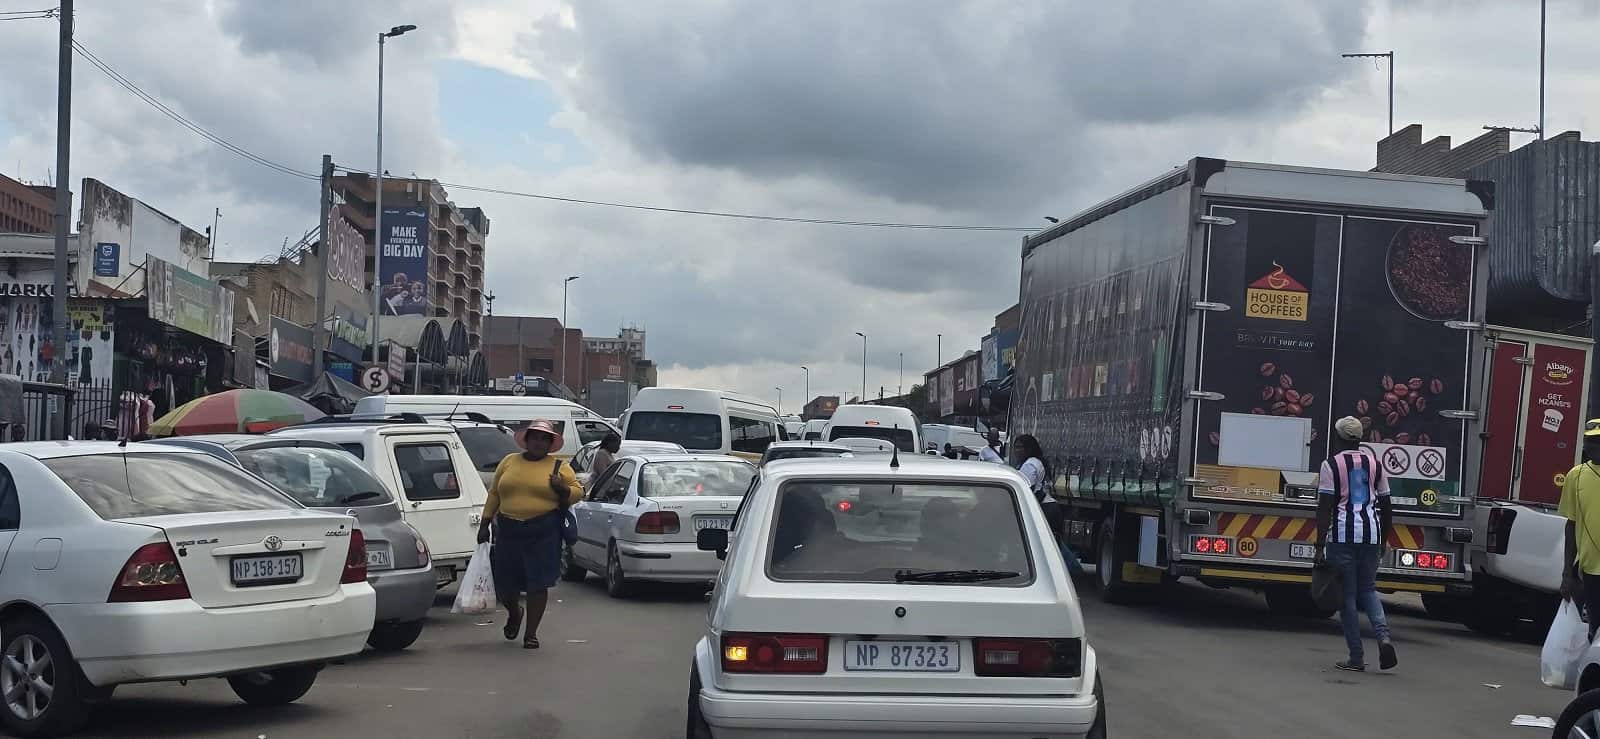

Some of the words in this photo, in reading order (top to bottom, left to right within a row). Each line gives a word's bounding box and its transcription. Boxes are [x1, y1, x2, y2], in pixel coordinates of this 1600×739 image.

[392, 226, 417, 238] MAKE
[383, 244, 401, 257] BIG
[403, 245, 424, 258] DAY
[0, 283, 74, 297] MARKT
[1251, 292, 1289, 305] HOUSE
[1290, 295, 1303, 304] OF
[1250, 303, 1303, 317] COFFEES
[1547, 362, 1571, 374] Albany
[1547, 393, 1563, 401] GET
[1422, 492, 1435, 502] 80
[1240, 540, 1255, 552] 80
[235, 561, 250, 578] NP
[253, 558, 297, 577] 158-157
[856, 644, 879, 666] NP
[891, 645, 949, 667] 87323
